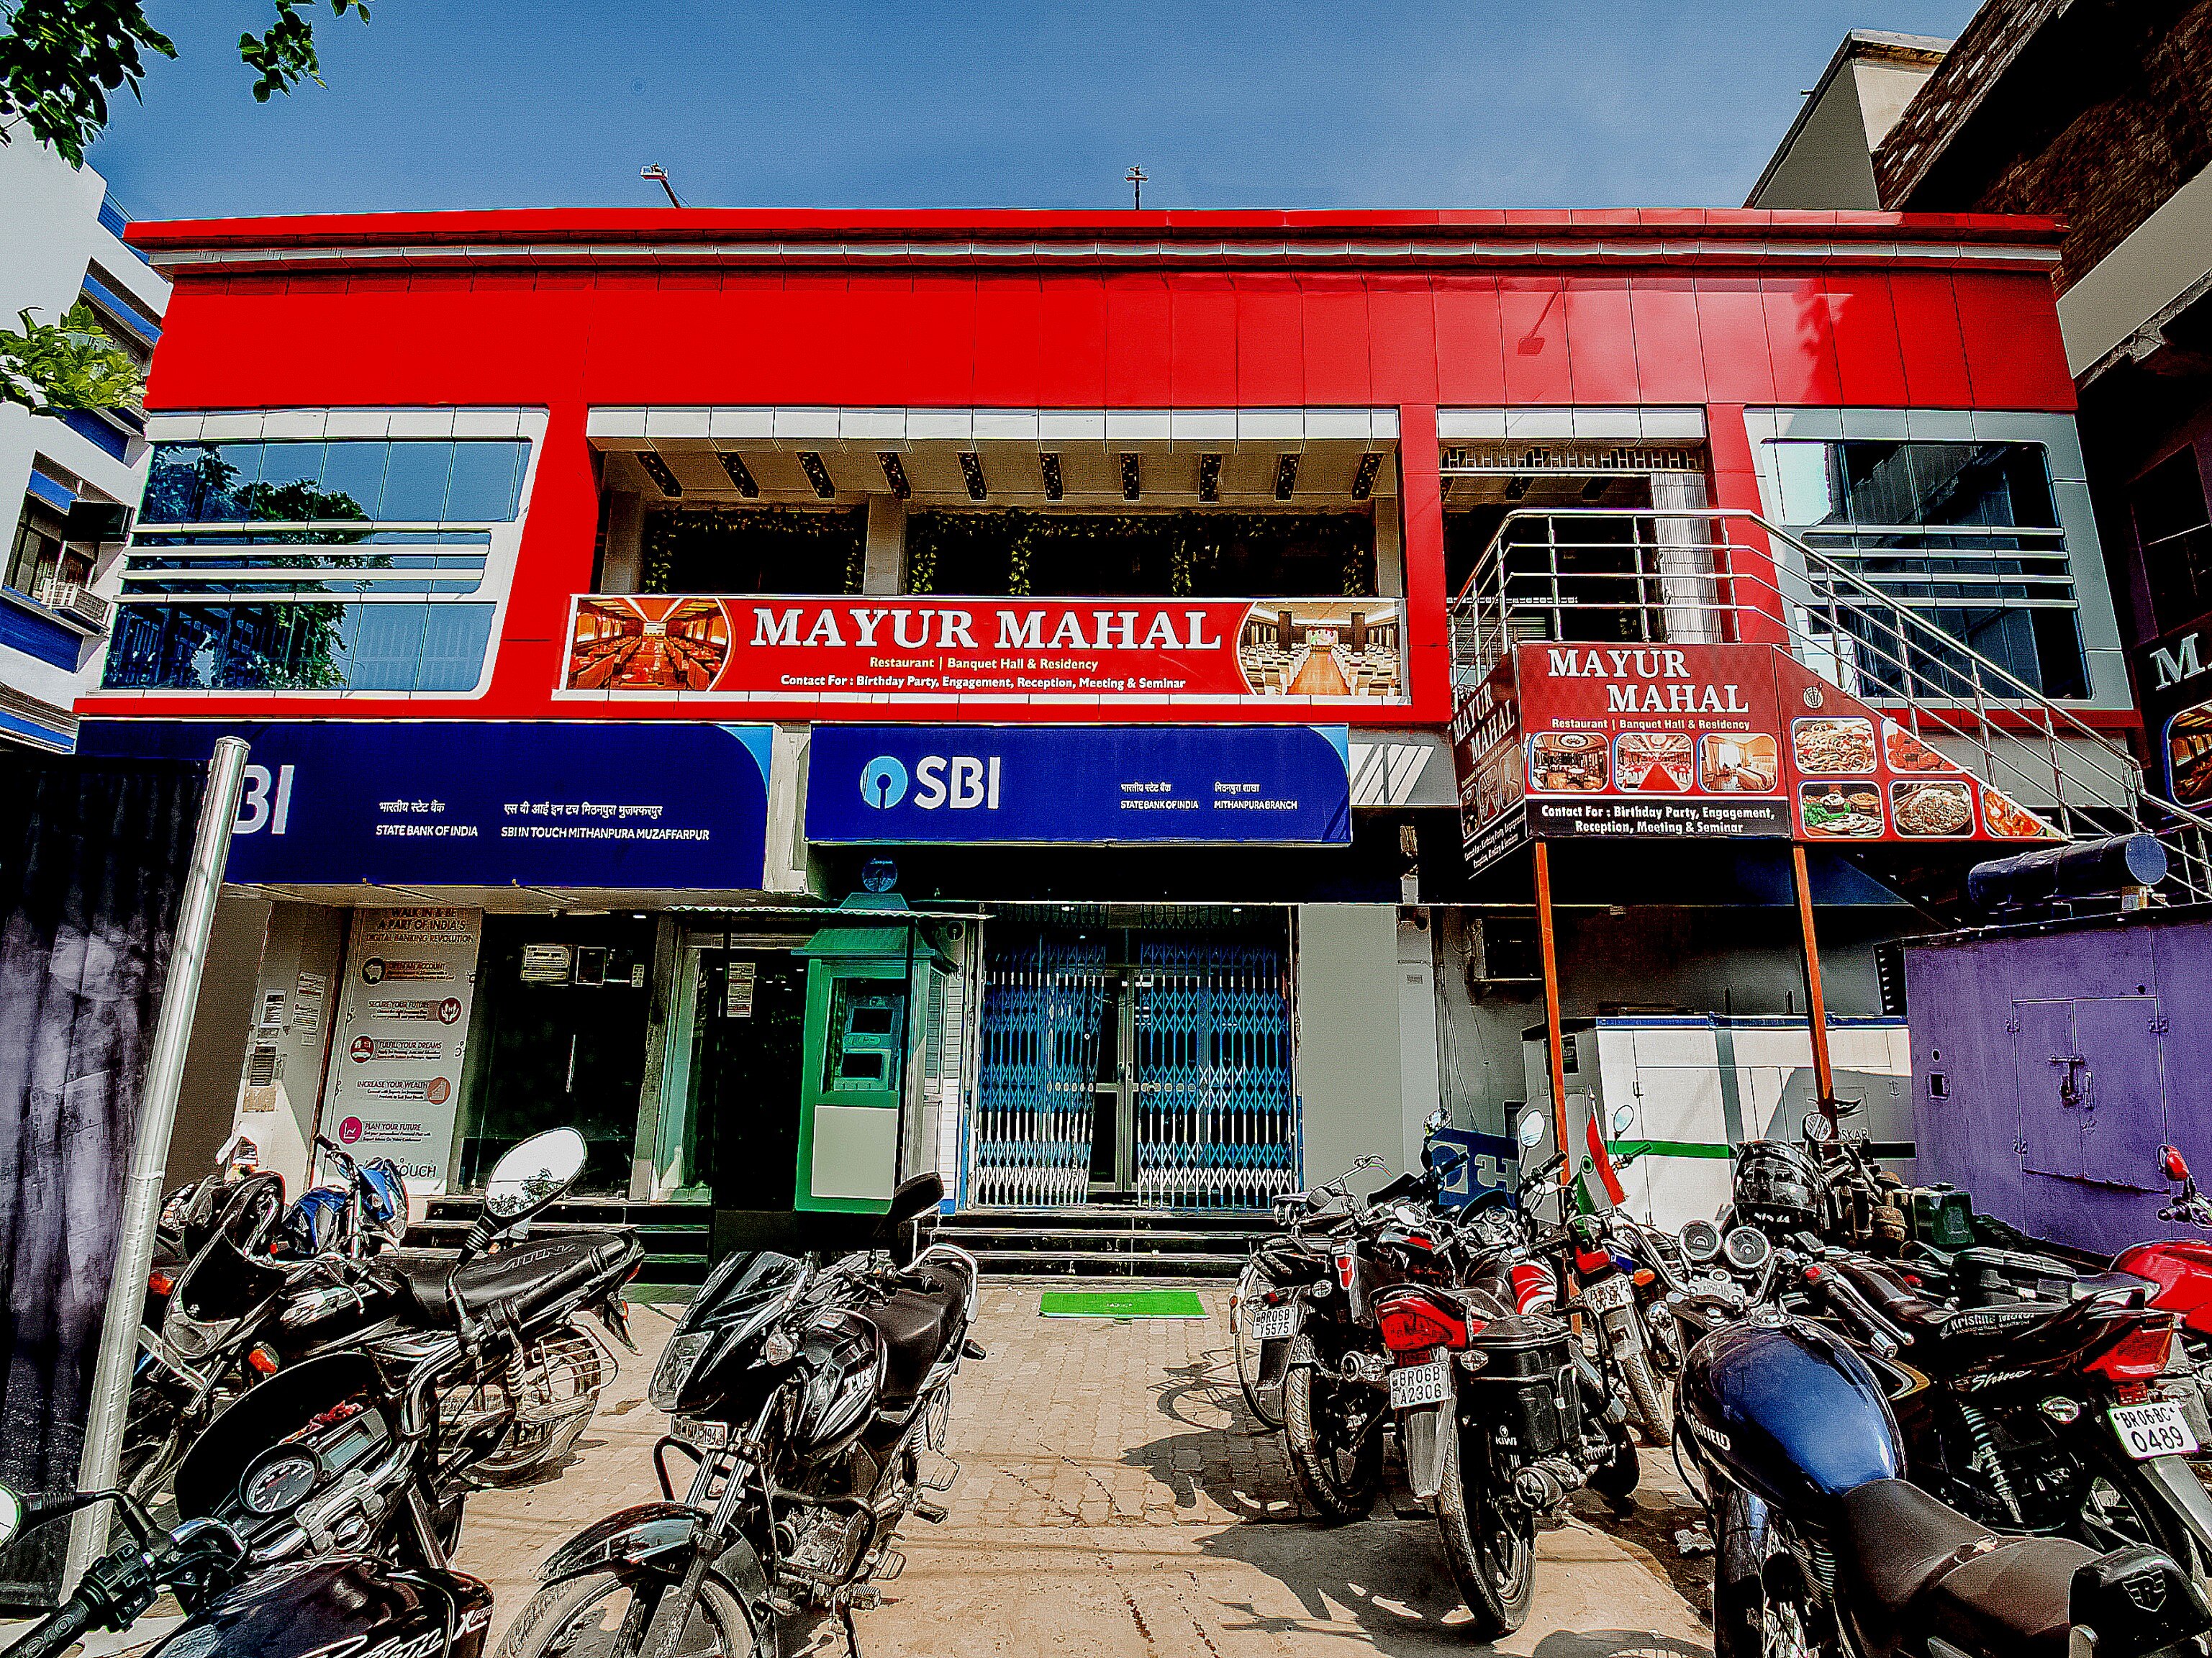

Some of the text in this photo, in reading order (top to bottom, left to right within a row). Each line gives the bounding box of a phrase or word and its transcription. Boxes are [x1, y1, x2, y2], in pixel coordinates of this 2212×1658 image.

[750, 608, 1222, 650] MAYUR MAHAL
[870, 656, 935, 669] Restaurant
[947, 657, 997, 671] Banquet
[1001, 658, 1024, 669] Hall
[1028, 658, 1037, 670] &
[1040, 658, 1098, 672] Residency
[1547, 648, 1690, 678] MAYUR
[781, 674, 825, 687] Contact
[828, 674, 848, 687] For
[856, 675, 905, 689] Birthday
[907, 676, 940, 689] Party,
[942, 676, 1014, 689] Engagement,
[1017, 676, 1075, 690] Reception,
[1079, 677, 1124, 691] Meeting
[1128, 678, 1137, 688] &
[1140, 677, 1186, 689] Seminar
[1606, 684, 1749, 713] MAHAL
[1453, 682, 1495, 746] MAYUR
[1470, 699, 1515, 765] MAHAL
[1551, 718, 1608, 729] Restaurant
[1619, 719, 1662, 732] Banquet
[1664, 719, 1685, 730] Hall
[1687, 720, 1696, 730] &
[1698, 720, 1750, 731] Residency
[914, 756, 1001, 810] SBI
[1121, 782, 1144, 792] भारतीय
[1145, 782, 1159, 792] स्टेट
[231, 764, 295, 835] BI
[379, 799, 445, 813] भारतीय स्टेट बैंक
[1120, 800, 1199, 810] STATE BANK OF INDIA
[1213, 800, 1297, 810] MITHANPURA BRANCH
[504, 804, 518, 815] एस
[532, 802, 549, 815] आई
[551, 804, 564, 816] इन
[566, 805, 579, 815] टच
[581, 802, 617, 818] मिठनपुरा
[1541, 805, 1582, 817] Contact
[1586, 806, 1604, 817] For
[1613, 806, 1662, 820] Birthday
[1666, 807, 1699, 820] Party,
[1703, 807, 1775, 820] Engagement,
[376, 825, 479, 837] STATE BANK OF INDIA
[501, 827, 710, 841] SBI IN TOUCH MITHANPURA MUZAFFARPUR
[1575, 820, 1744, 835] Reception, Meeting & Seminar
[389, 919, 412, 930] PART
[414, 919, 429, 930] OF
[404, 1081, 428, 1090] WEALTH
[398, 1164, 437, 1178] OUCH
[1261, 1308, 1289, 1323] BR06B
[1261, 1321, 1289, 1336] Y5575
[843, 1367, 873, 1395] TVS
[1400, 1366, 1441, 1387] BR06B
[1400, 1383, 1442, 1405] A2306
[2131, 1426, 2184, 1452] 0489
